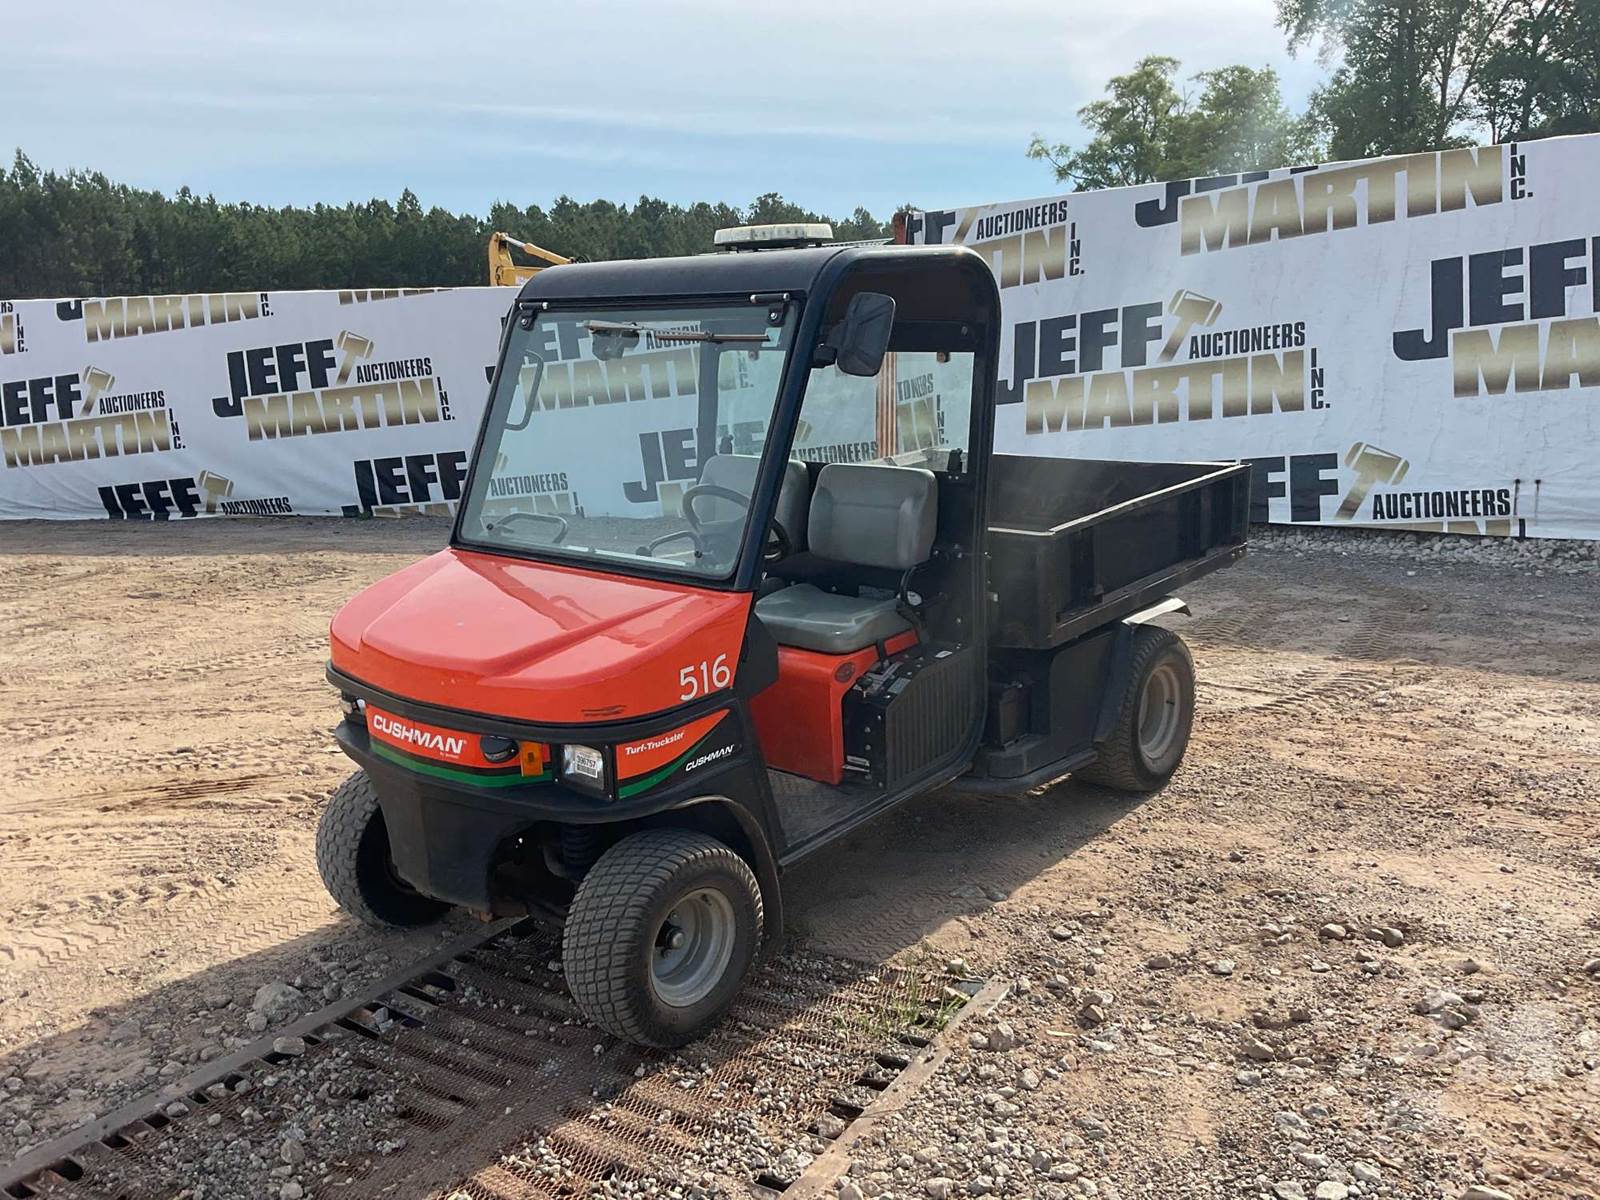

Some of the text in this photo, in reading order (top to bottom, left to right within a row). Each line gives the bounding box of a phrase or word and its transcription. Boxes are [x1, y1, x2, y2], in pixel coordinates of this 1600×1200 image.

[1511, 143, 1533, 199] INC.
[976, 200, 1067, 240] AUCTIONEERS
[1181, 144, 1502, 256] MARTIN
[1070, 222, 1085, 276] INC.
[84, 294, 259, 343] MARTIN
[260, 294, 274, 317] NC.
[16, 313, 29, 352] INC.
[996, 301, 1163, 405] JEFF
[1189, 322, 1306, 360] AUCTIONEERS
[212, 338, 337, 418] JEFF
[356, 357, 433, 384] AUCTIONEERS
[1025, 349, 1305, 435] MARTIN
[1310, 347, 1331, 410] INC.
[0, 373, 82, 427] EFF
[99, 390, 165, 415] AUCTIONEERS
[243, 377, 440, 441] MARTIN
[436, 376, 456, 421] INC.
[936, 393, 950, 445] INC.
[0, 409, 171, 469] MARTIN
[169, 408, 186, 449] INC.
[220, 496, 293, 516] AUCTIONEERS
[341, 450, 468, 520] JEFF
[489, 472, 569, 497] AUCTIONEERS
[1241, 452, 1339, 523] FF
[1372, 488, 1511, 520] AUCTIONEERS
[679, 653, 731, 701] 516
[373, 714, 464, 754] CUSHMAN
[625, 731, 686, 755] Turf-Truckster
[685, 744, 736, 772] CUSHMAN
